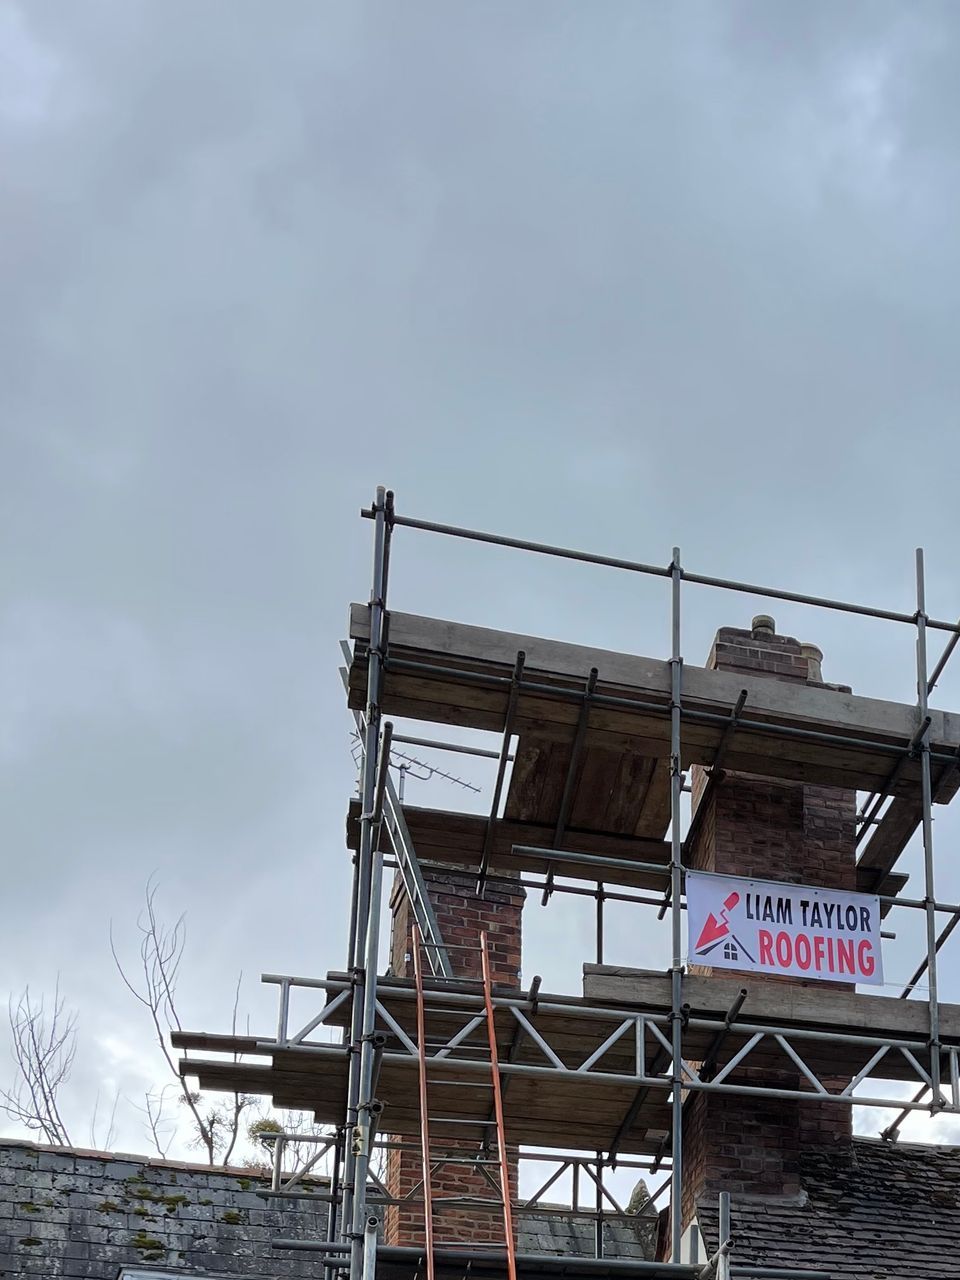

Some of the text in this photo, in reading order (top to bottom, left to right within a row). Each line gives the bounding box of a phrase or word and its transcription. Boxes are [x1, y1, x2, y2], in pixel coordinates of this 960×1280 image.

[746, 893, 872, 933] LIAM TAYLOR
[758, 929, 875, 977] ROOFING
